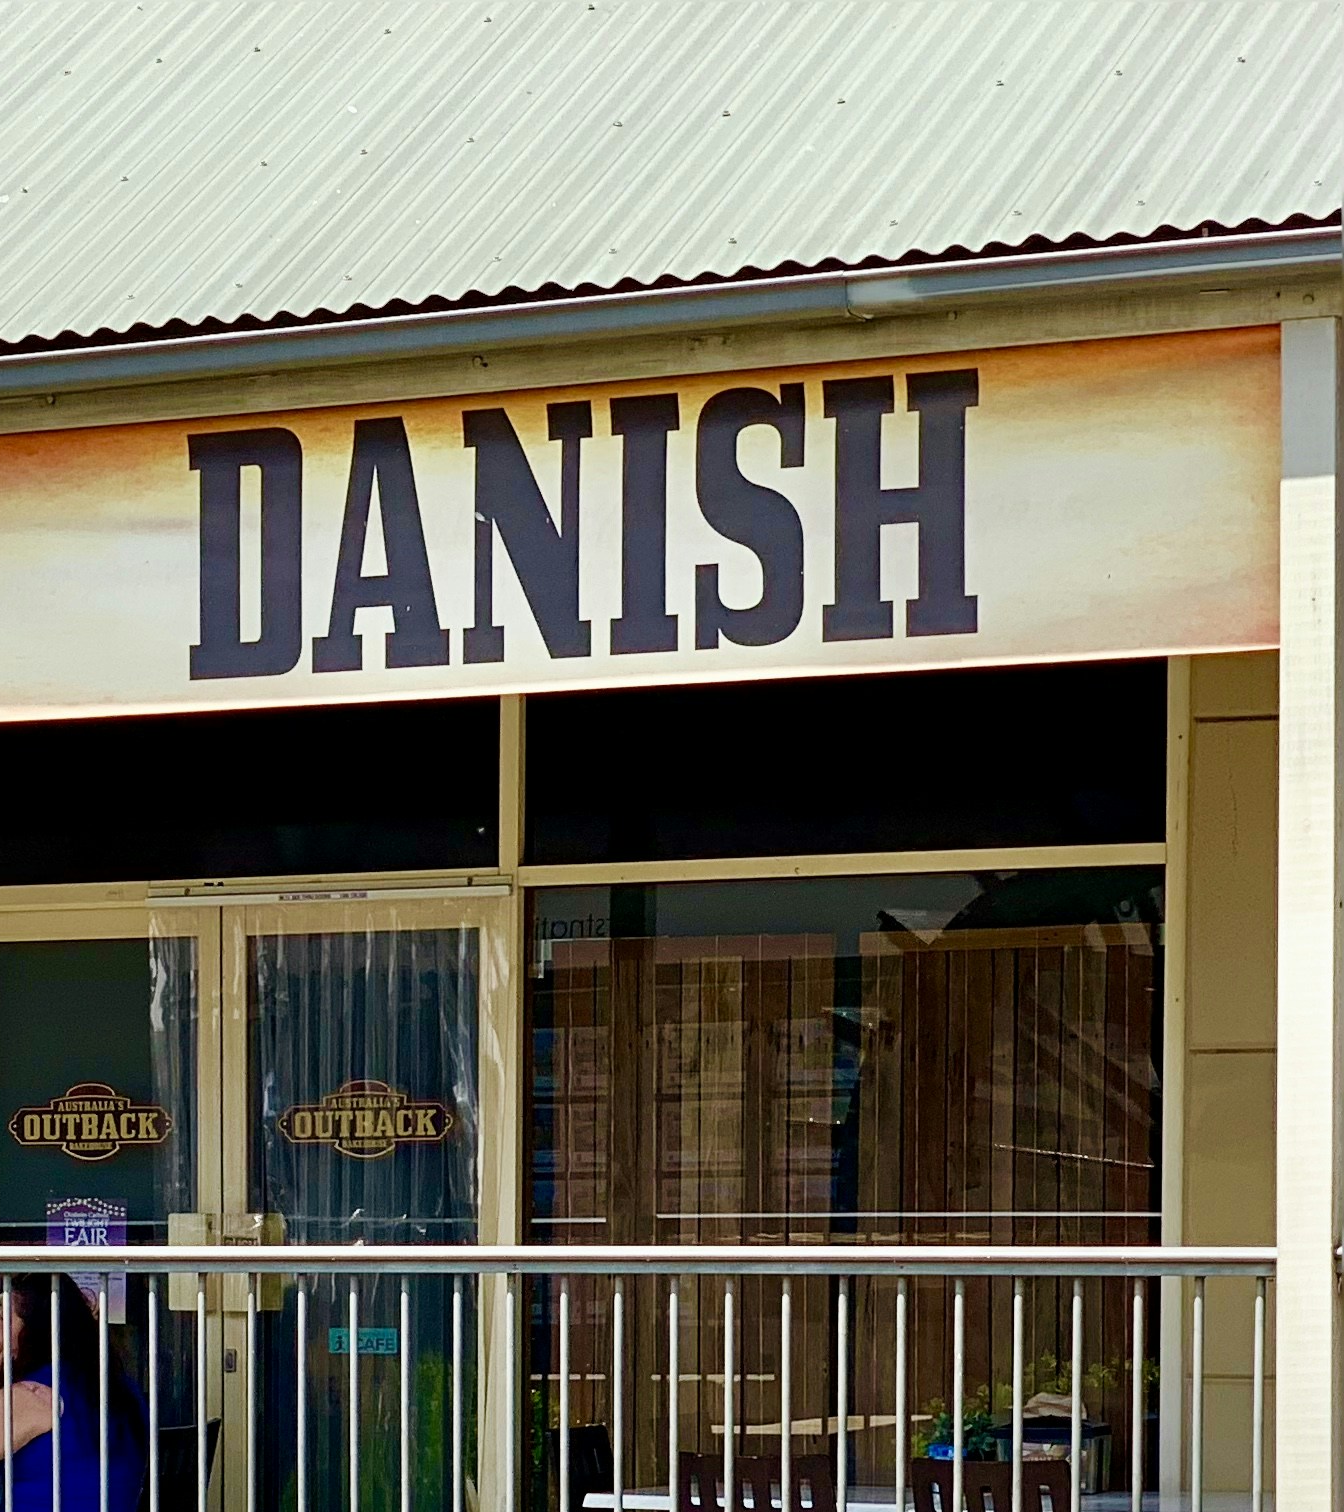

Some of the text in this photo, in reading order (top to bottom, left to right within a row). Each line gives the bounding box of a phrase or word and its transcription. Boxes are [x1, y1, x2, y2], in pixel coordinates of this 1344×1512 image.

[188, 368, 978, 681] DANISH
[57, 1100, 124, 1111] AUSTRALIA'S
[330, 1097, 400, 1108] AUSTRALIA'S
[23, 1112, 158, 1140] OUTBACK
[294, 1109, 437, 1138] OUTBACK
[64, 1227, 109, 1245] FAIR
